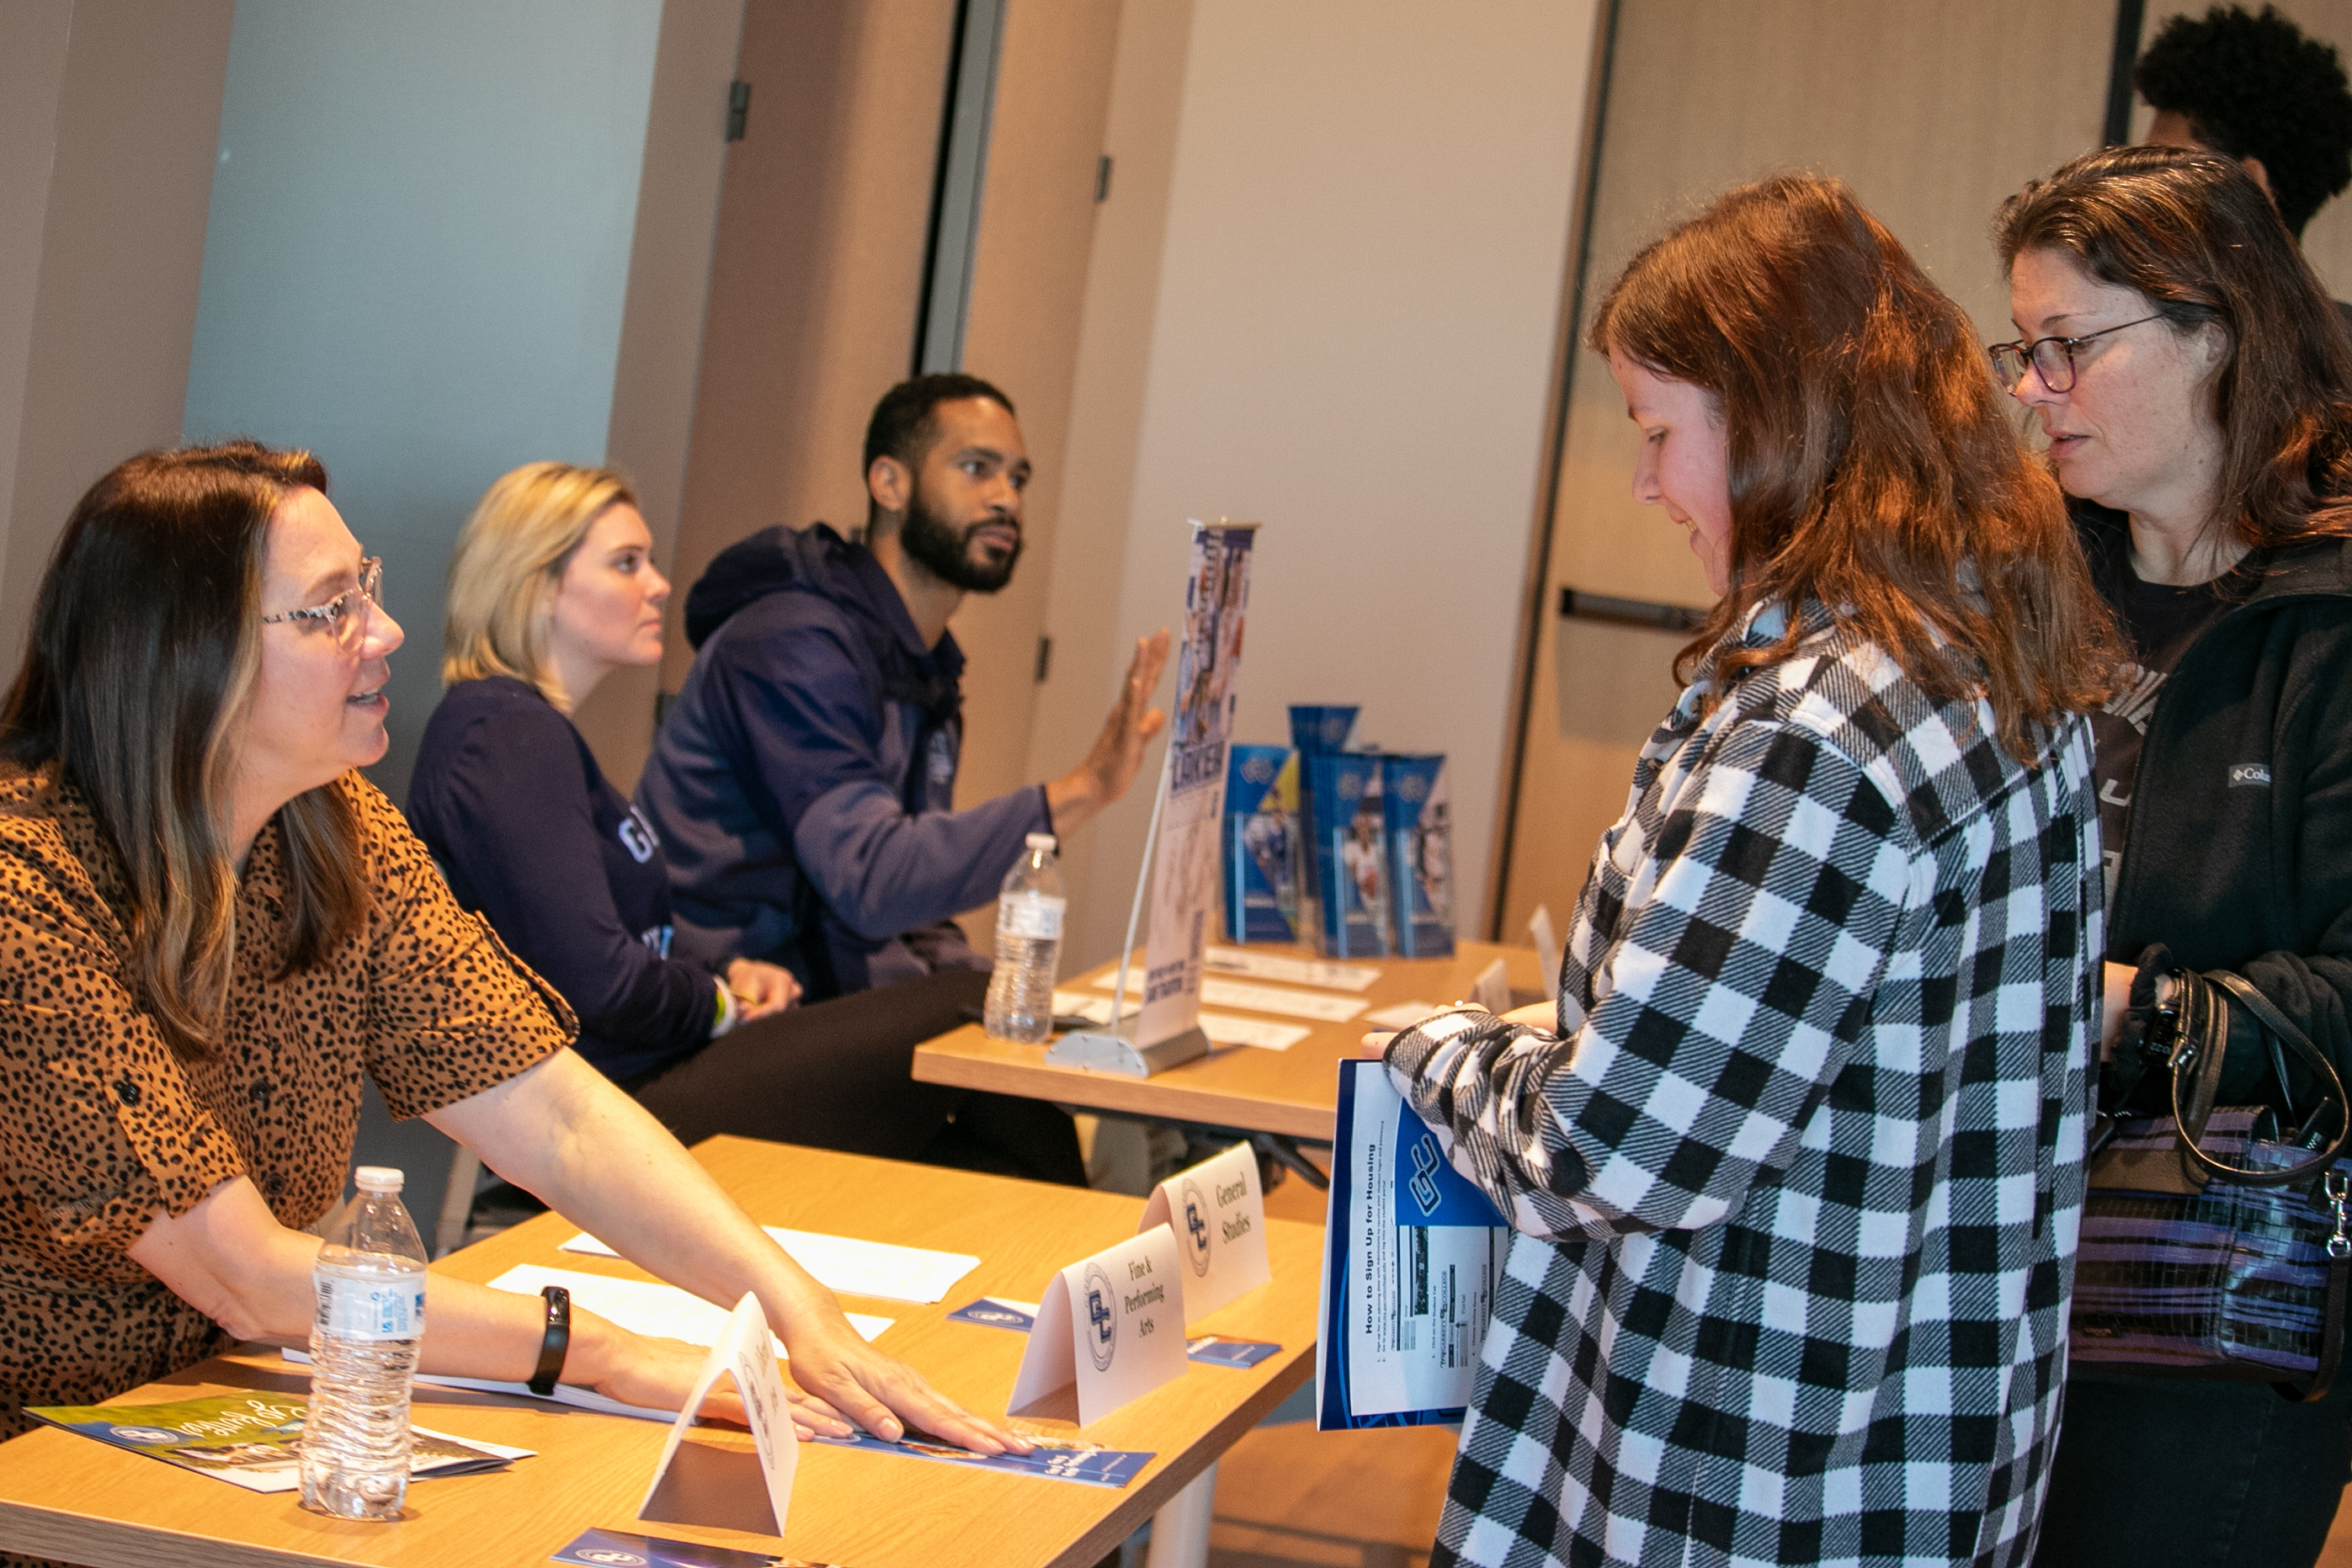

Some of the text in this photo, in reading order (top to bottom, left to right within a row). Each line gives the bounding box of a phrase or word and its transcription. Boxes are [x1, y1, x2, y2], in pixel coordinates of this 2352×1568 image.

[1366, 1144, 1376, 1200] Housing
[1216, 1172, 1248, 1209] General
[1221, 1212, 1251, 1245] Studies
[1365, 1228, 1374, 1246] Up
[1127, 1255, 1153, 1282] Fine &
[1365, 1252, 1374, 1281] Sign
[1124, 1281, 1165, 1315] Performing
[1365, 1285, 1372, 1299] to
[1138, 1316, 1155, 1339] Arts
